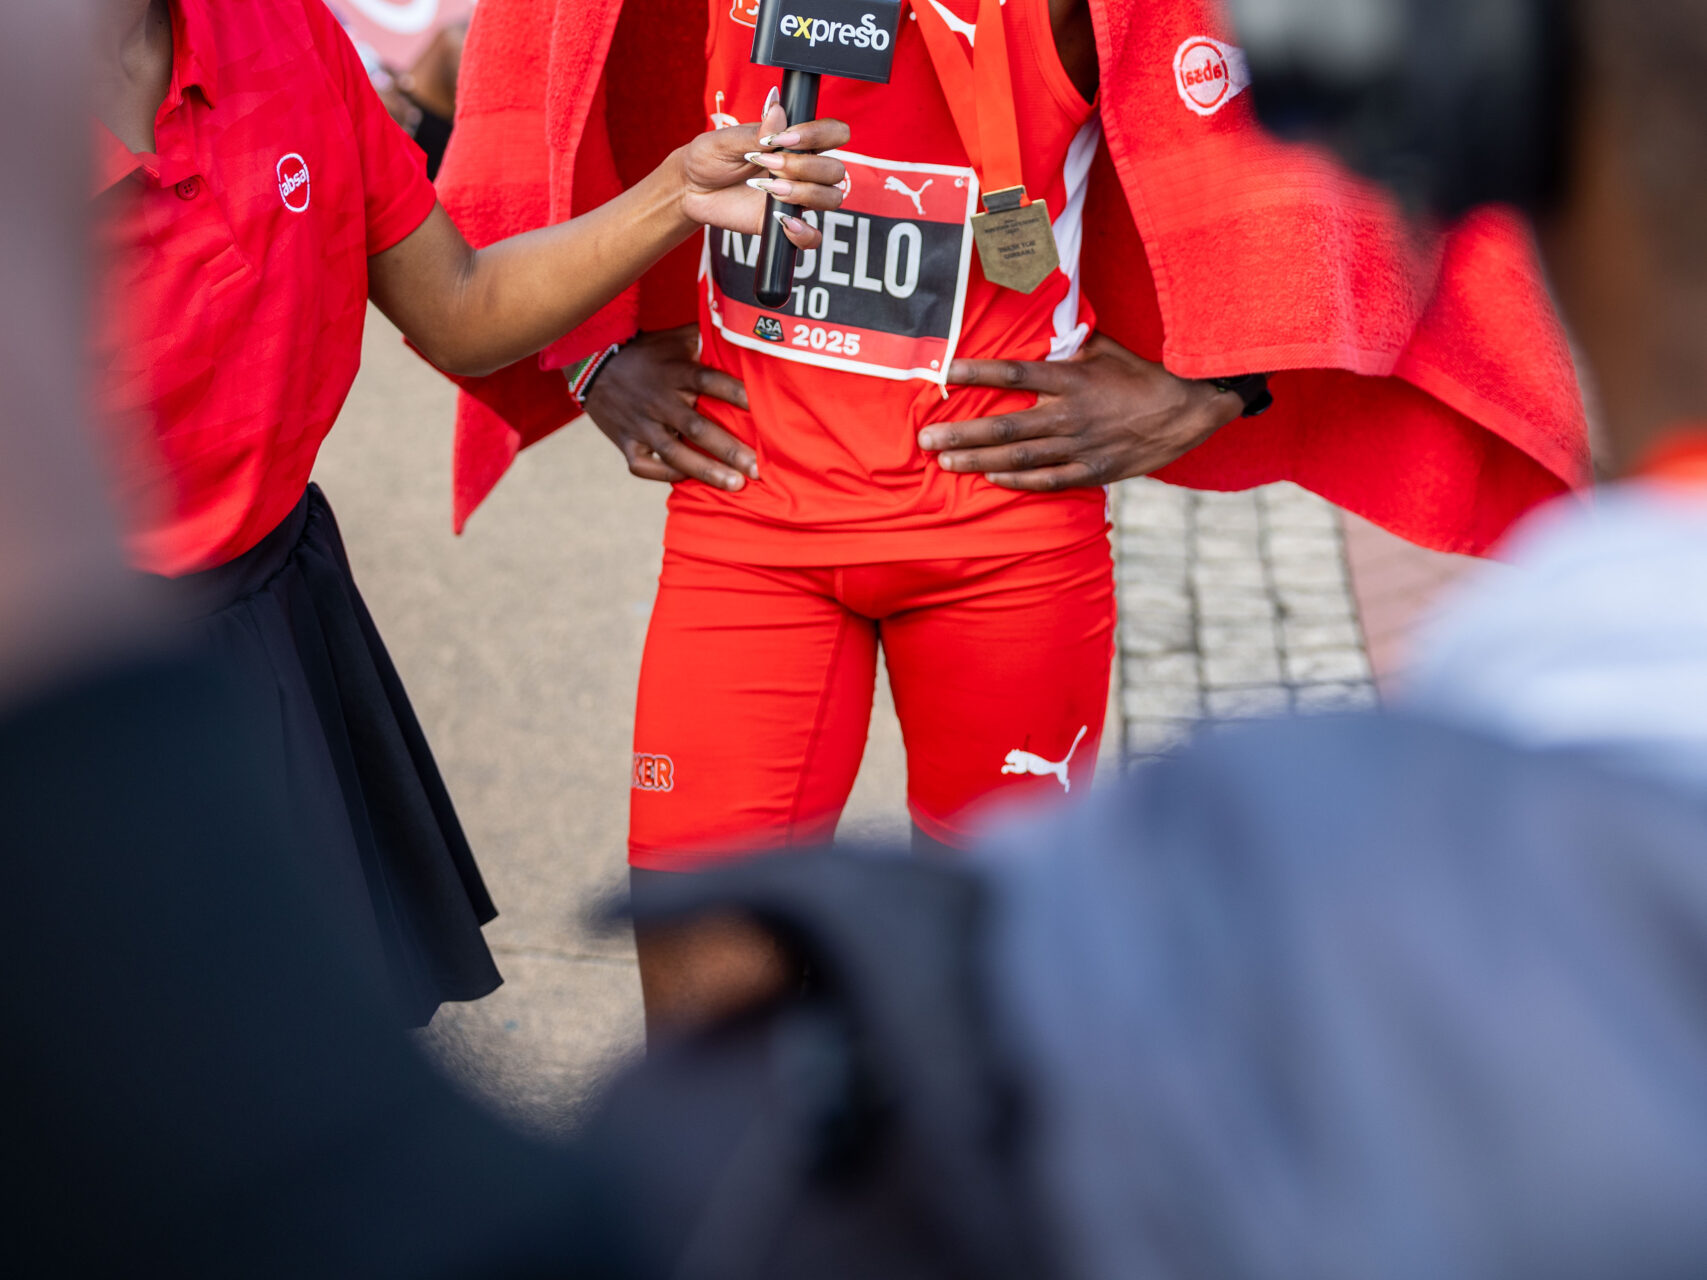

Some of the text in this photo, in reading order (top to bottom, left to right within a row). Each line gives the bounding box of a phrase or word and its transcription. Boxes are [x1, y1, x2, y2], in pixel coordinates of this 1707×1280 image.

[780, 14, 890, 51] expresso
[282, 169, 307, 196] absa
[792, 285, 829, 320] 10
[757, 317, 782, 333] ASA
[792, 324, 860, 356] 2025
